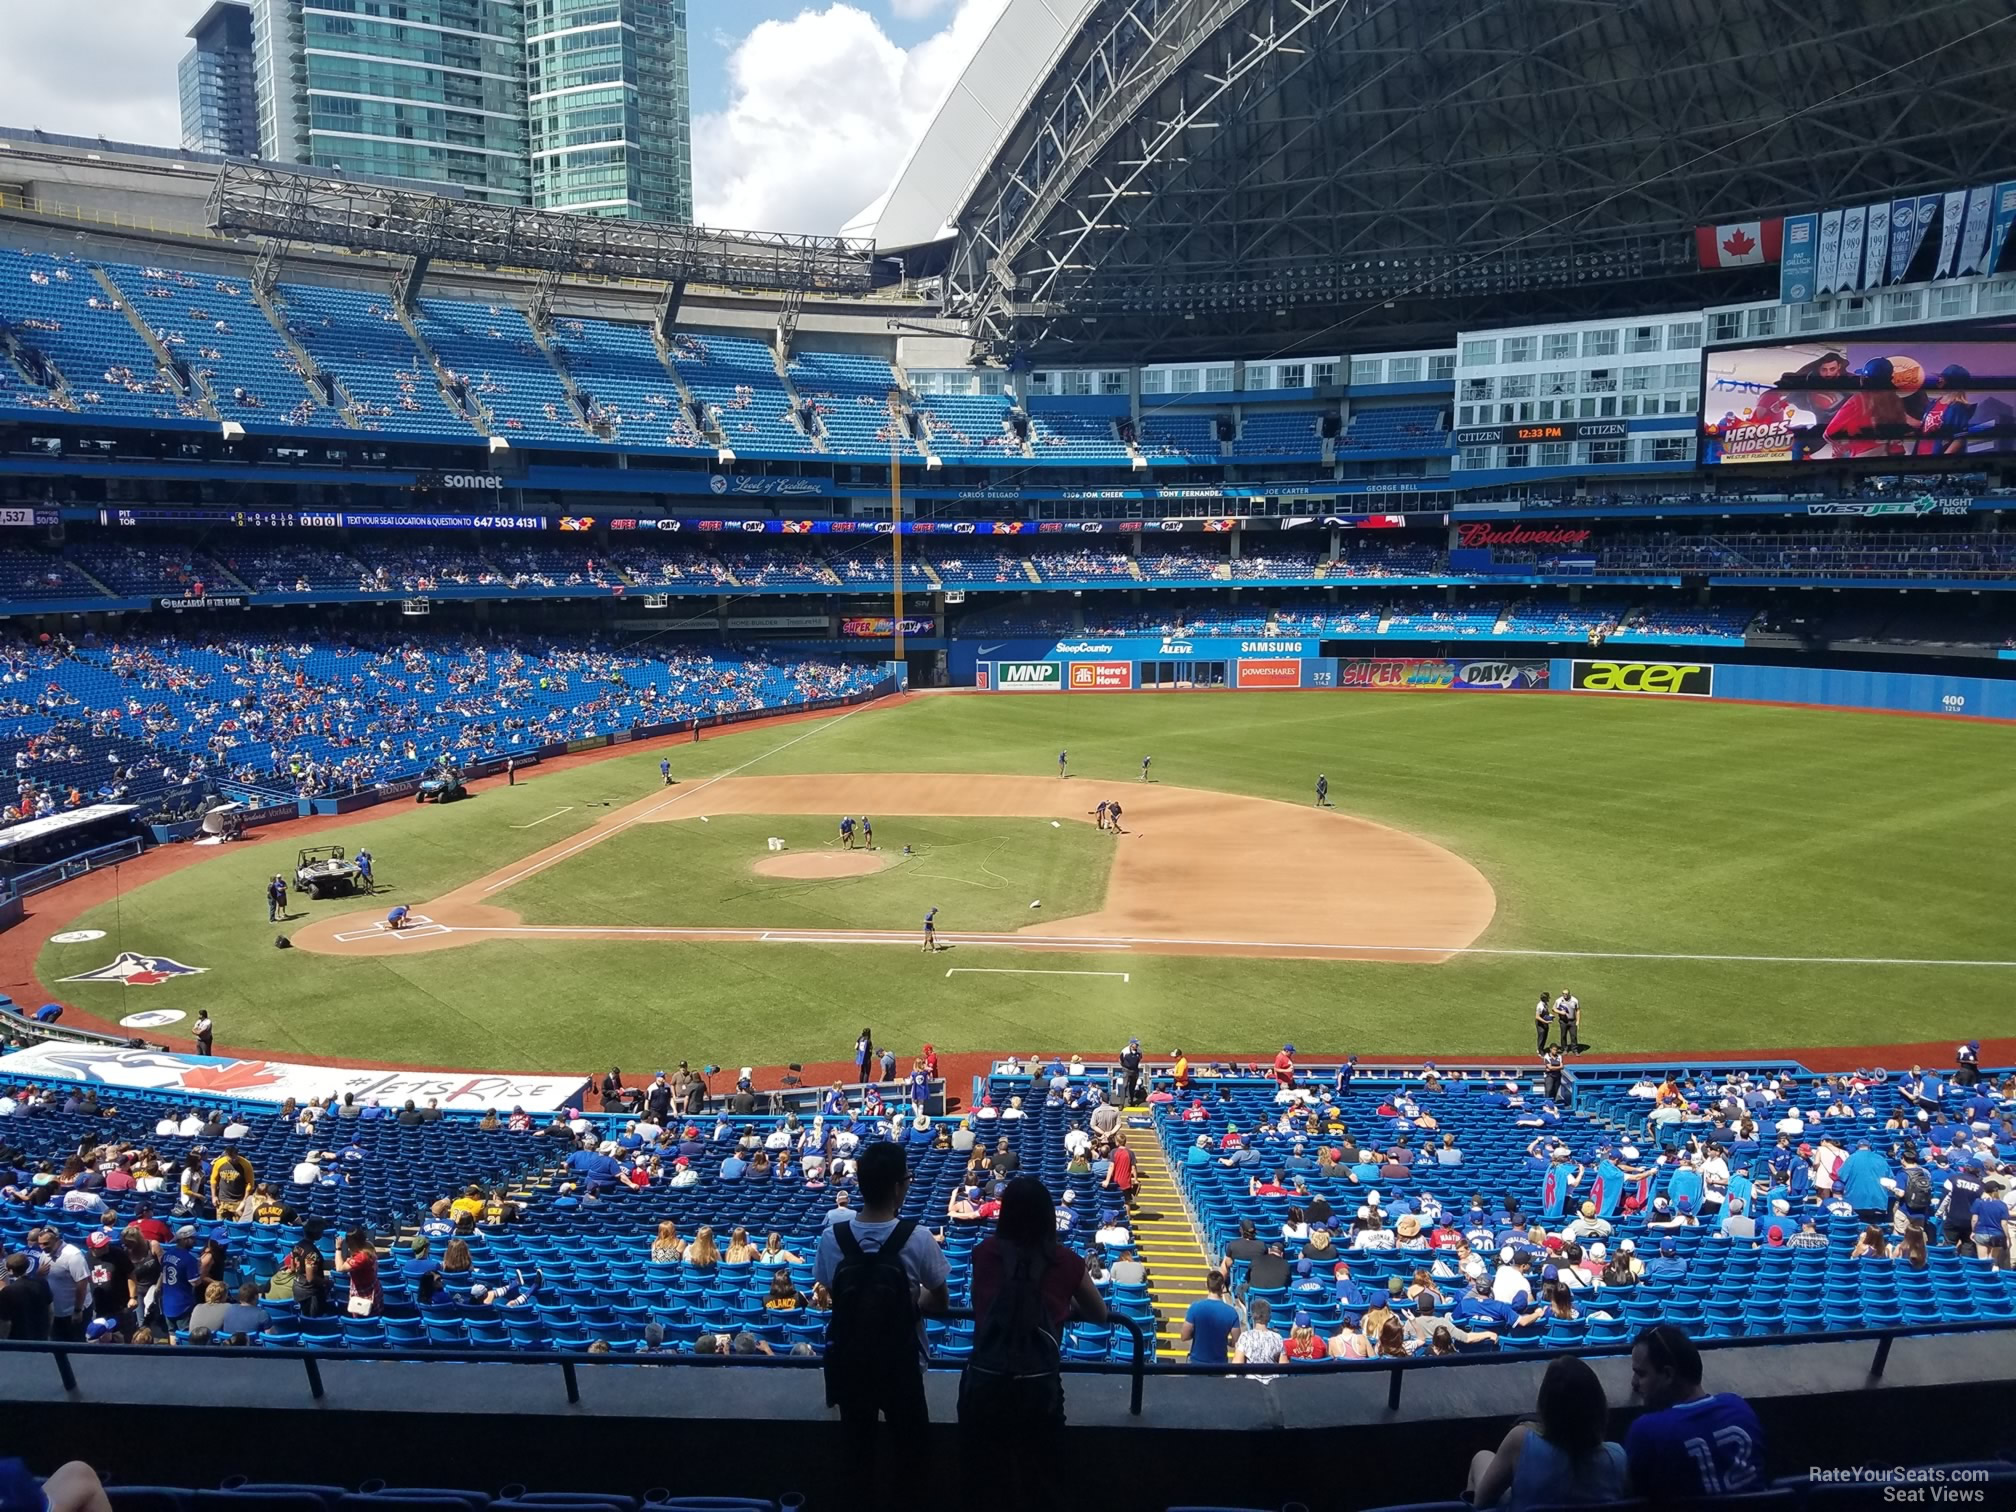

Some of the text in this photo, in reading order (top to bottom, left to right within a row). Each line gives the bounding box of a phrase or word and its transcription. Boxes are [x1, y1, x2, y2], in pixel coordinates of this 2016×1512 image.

[1869, 234, 1887, 248] 1991
[1893, 230, 1910, 244] 1992
[1842, 238, 1860, 250] 1989
[1786, 258, 1811, 266] GILLICK
[1518, 427, 1561, 439] 12:33 PM
[1579, 424, 1625, 436] CITIZEN
[1725, 420, 1790, 443] HEROES
[1457, 431, 1501, 443] CITIZEN
[1732, 433, 1794, 454] HIDEOUT
[444, 474, 503, 489] sonnet
[731, 475, 822, 494] Level of Excellence
[958, 491, 1019, 499] CARLOS DELGADO
[1938, 497, 1974, 507] FLIGHT
[118, 510, 131, 518] PIT
[1808, 502, 1913, 516] WESTJET
[1942, 506, 1968, 515] DECK
[0, 510, 26, 524] ,537
[36, 516, 59, 525] 50/50
[119, 518, 136, 526] TOR
[346, 516, 471, 526] TEXT YOUR SEAT LOCATION & QUESTION TO
[473, 517, 537, 528] 647 503 4131
[611, 519, 636, 530] SUPER
[698, 521, 722, 531] SUPER
[831, 522, 855, 532] SUPER
[912, 522, 935, 532] SUPER
[1039, 522, 1062, 532] SUPER
[1119, 522, 1142, 531] SUPER
[1457, 521, 1592, 547] Budweiser
[225, 597, 241, 606] PARK
[843, 621, 871, 634] SUPER
[899, 621, 918, 631] DAY!
[1241, 642, 1302, 652] SAMSUNG
[1007, 665, 1053, 682] MNP
[1096, 666, 1127, 675] Here's
[1342, 660, 1516, 686] SUPER JAYS DAY!
[1096, 676, 1121, 685] How.
[1313, 672, 1332, 681] 375
[1582, 662, 1701, 693] acer
[1942, 695, 1965, 706] 400
[514, 756, 537, 767] HONDA
[163, 786, 193, 802] Standard
[378, 782, 413, 797] HONDA
[1956, 1179, 1980, 1192] STAFF
[1544, 1173, 1556, 1211] R
[258, 1206, 283, 1216] POLANCO
[1471, 1240, 1494, 1250] 20
[162, 1266, 178, 1286] 13
[1684, 1425, 1757, 1494] 12
